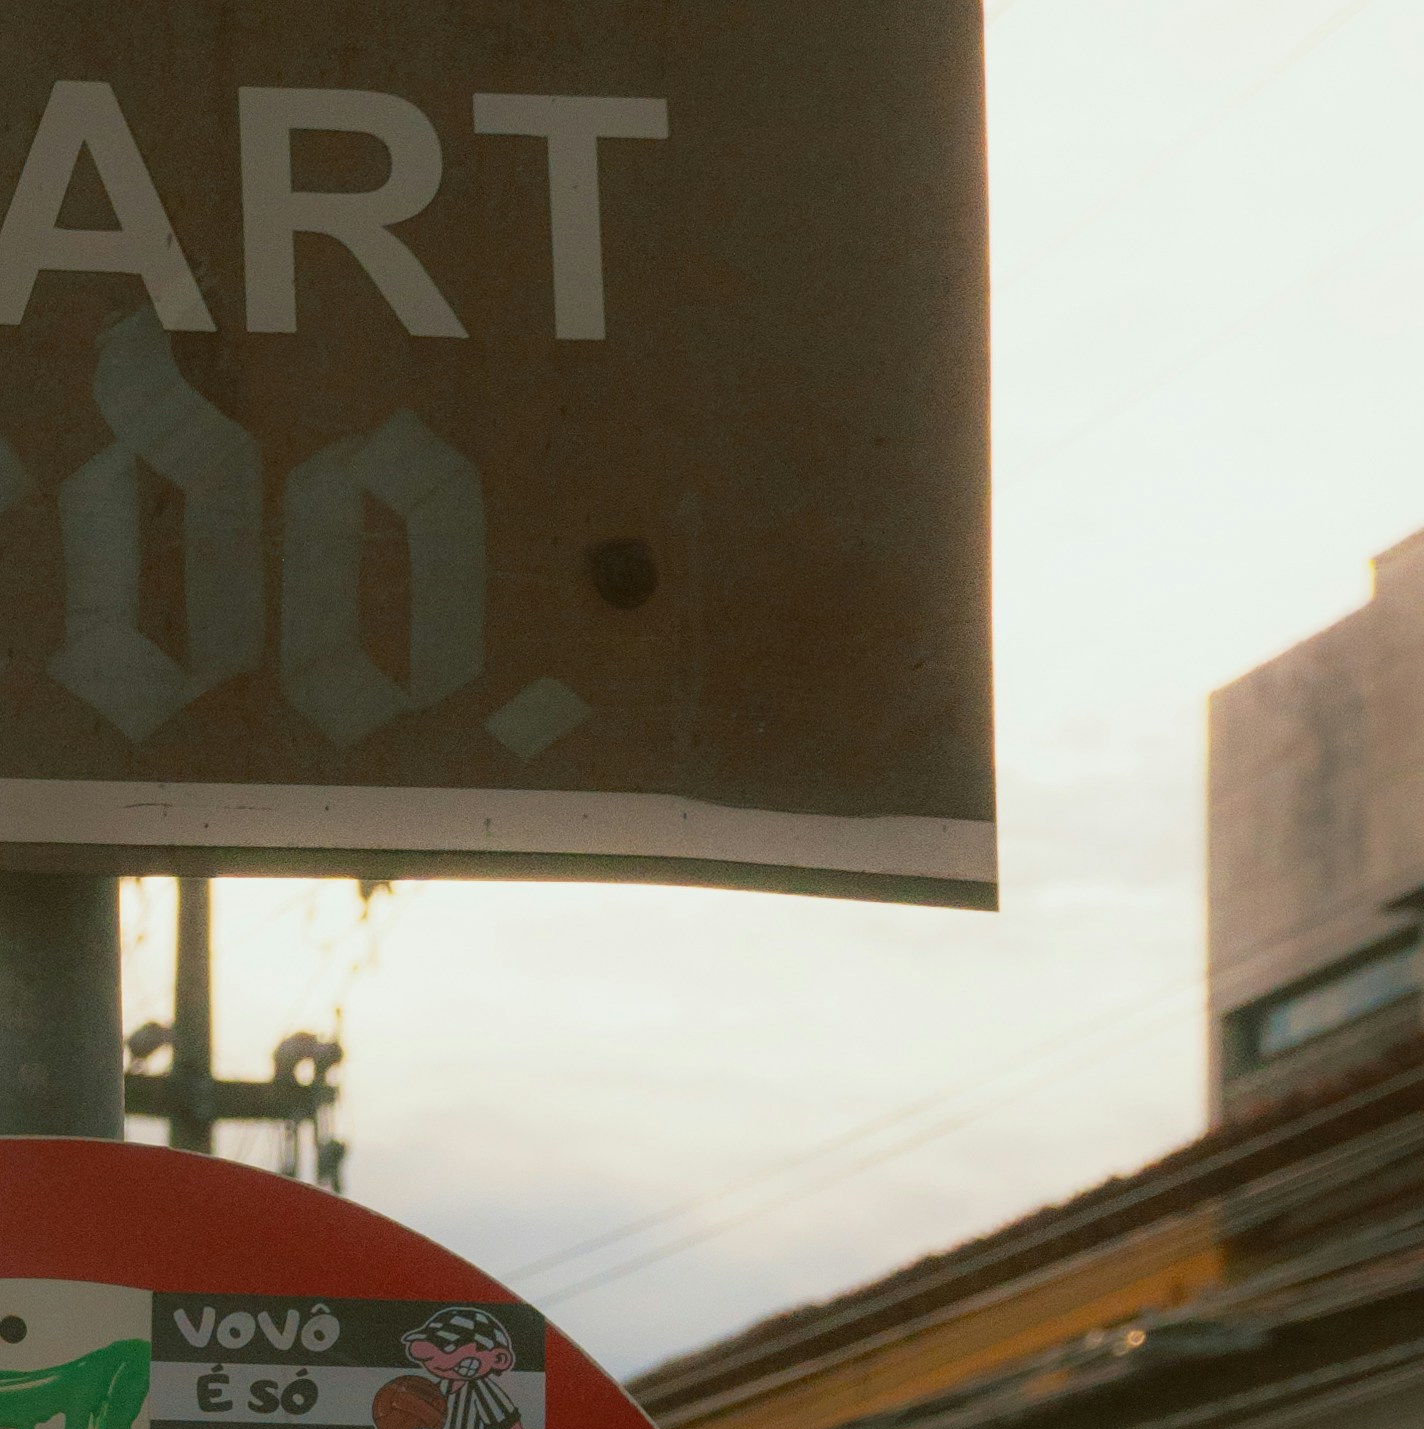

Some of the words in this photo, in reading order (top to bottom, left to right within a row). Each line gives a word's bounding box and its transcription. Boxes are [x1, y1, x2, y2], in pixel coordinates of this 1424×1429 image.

[173, 1302, 341, 1352] VOVÔ
[195, 1363, 231, 1413] É
[247, 1368, 319, 1416] SÓ
